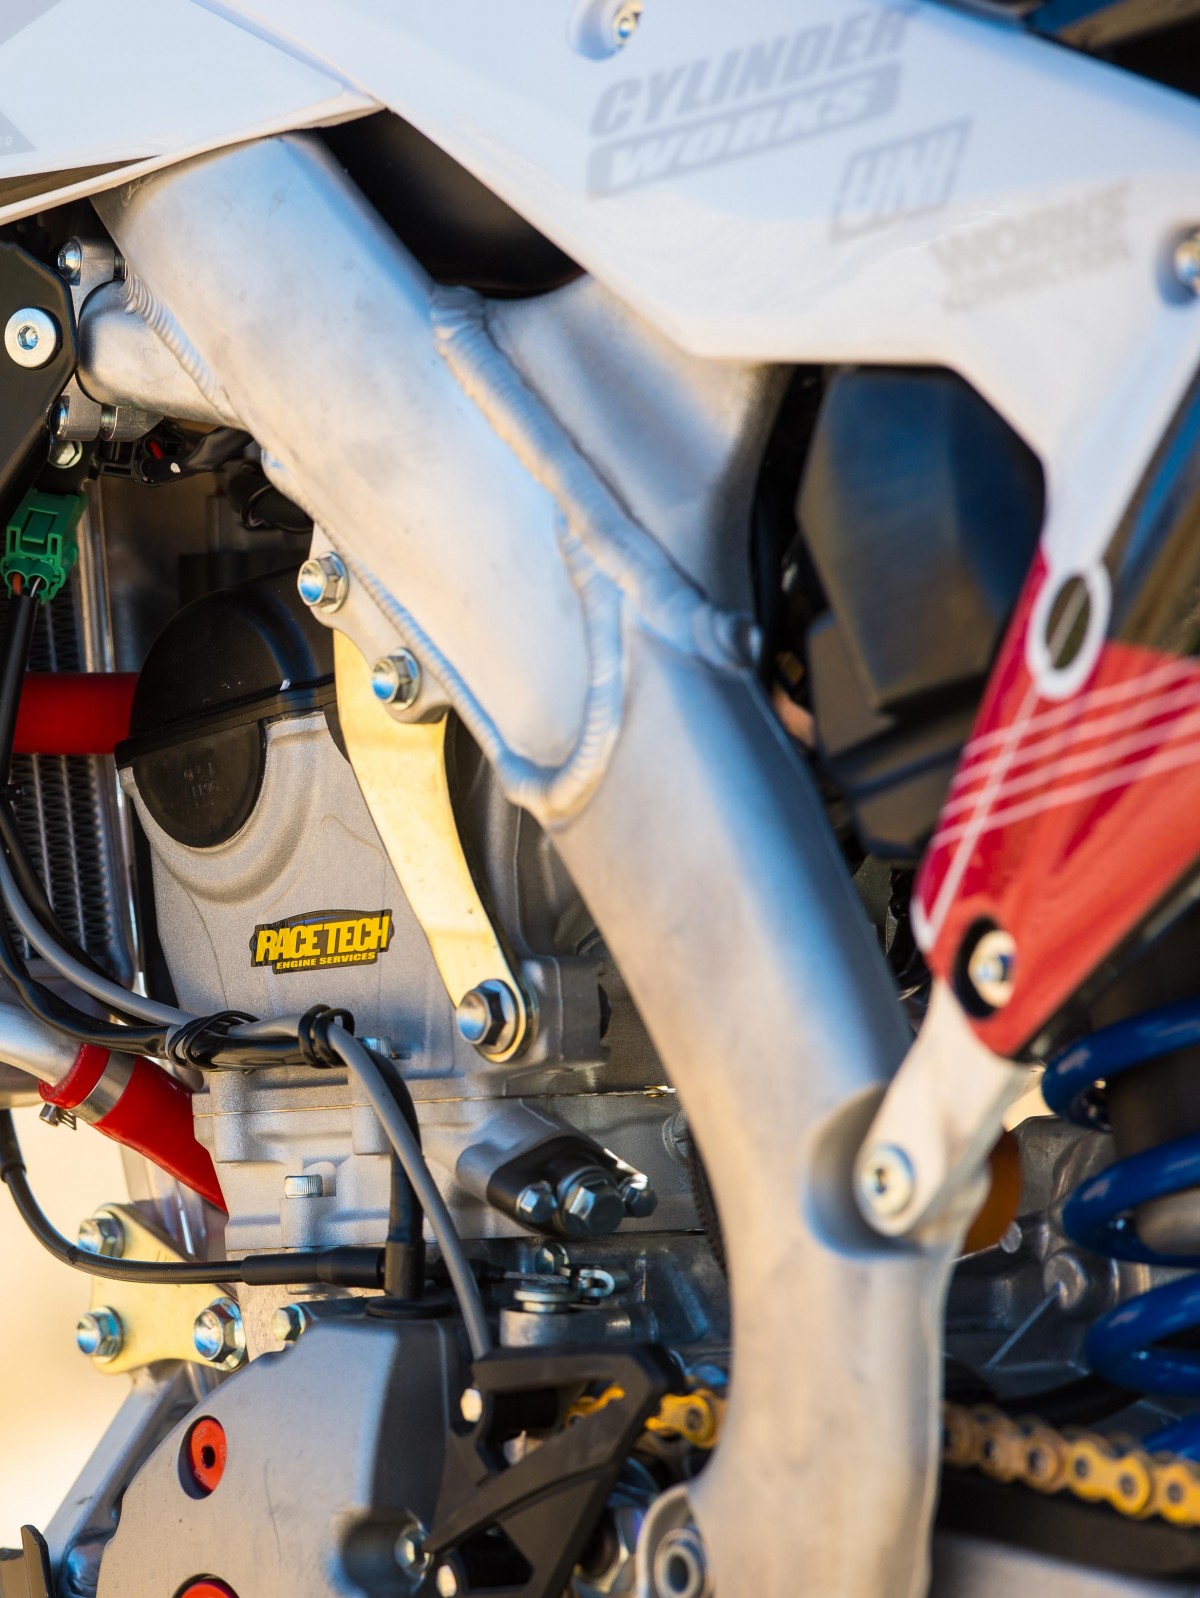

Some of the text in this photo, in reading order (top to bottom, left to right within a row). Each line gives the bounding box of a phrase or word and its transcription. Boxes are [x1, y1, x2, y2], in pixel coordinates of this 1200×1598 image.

[590, 7, 910, 137] CYLINDER
[608, 76, 876, 188] WORKS
[836, 122, 960, 233] UNI
[276, 951, 376, 970] ENGINE SERVICES
